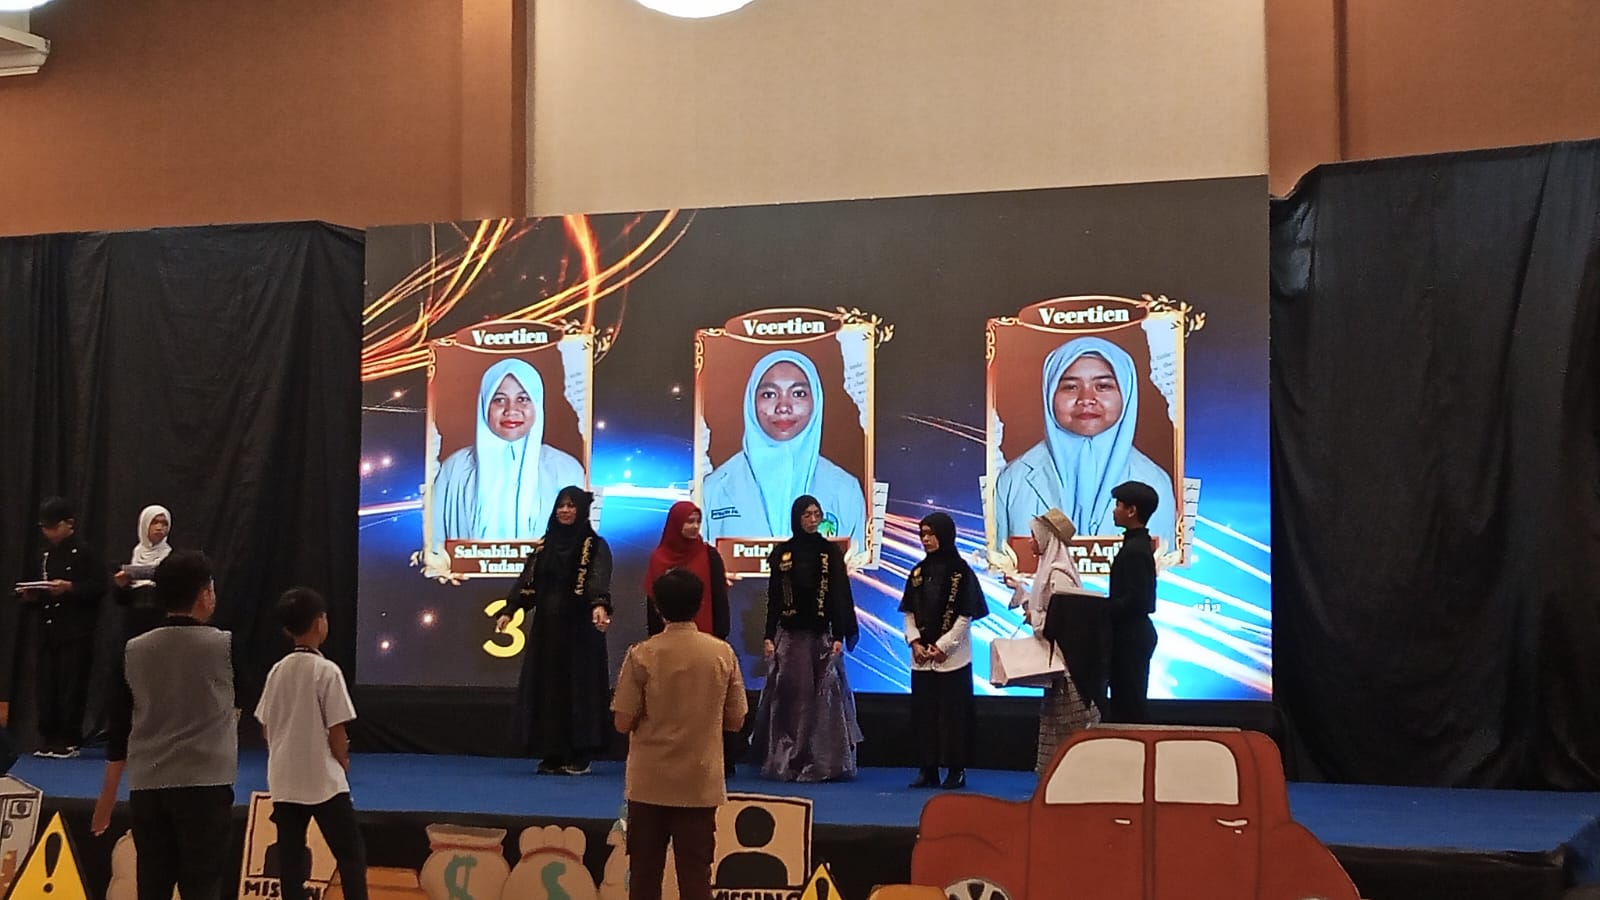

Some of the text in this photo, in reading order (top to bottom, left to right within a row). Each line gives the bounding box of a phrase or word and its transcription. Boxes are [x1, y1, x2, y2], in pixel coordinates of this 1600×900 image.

[1038, 305, 1130, 326] Veertien
[471, 327, 548, 346] Veertien
[743, 317, 826, 337] Veertien
[454, 544, 519, 559] Salsabila
[1073, 558, 1111, 573] fira
[482, 599, 526, 658] 3
